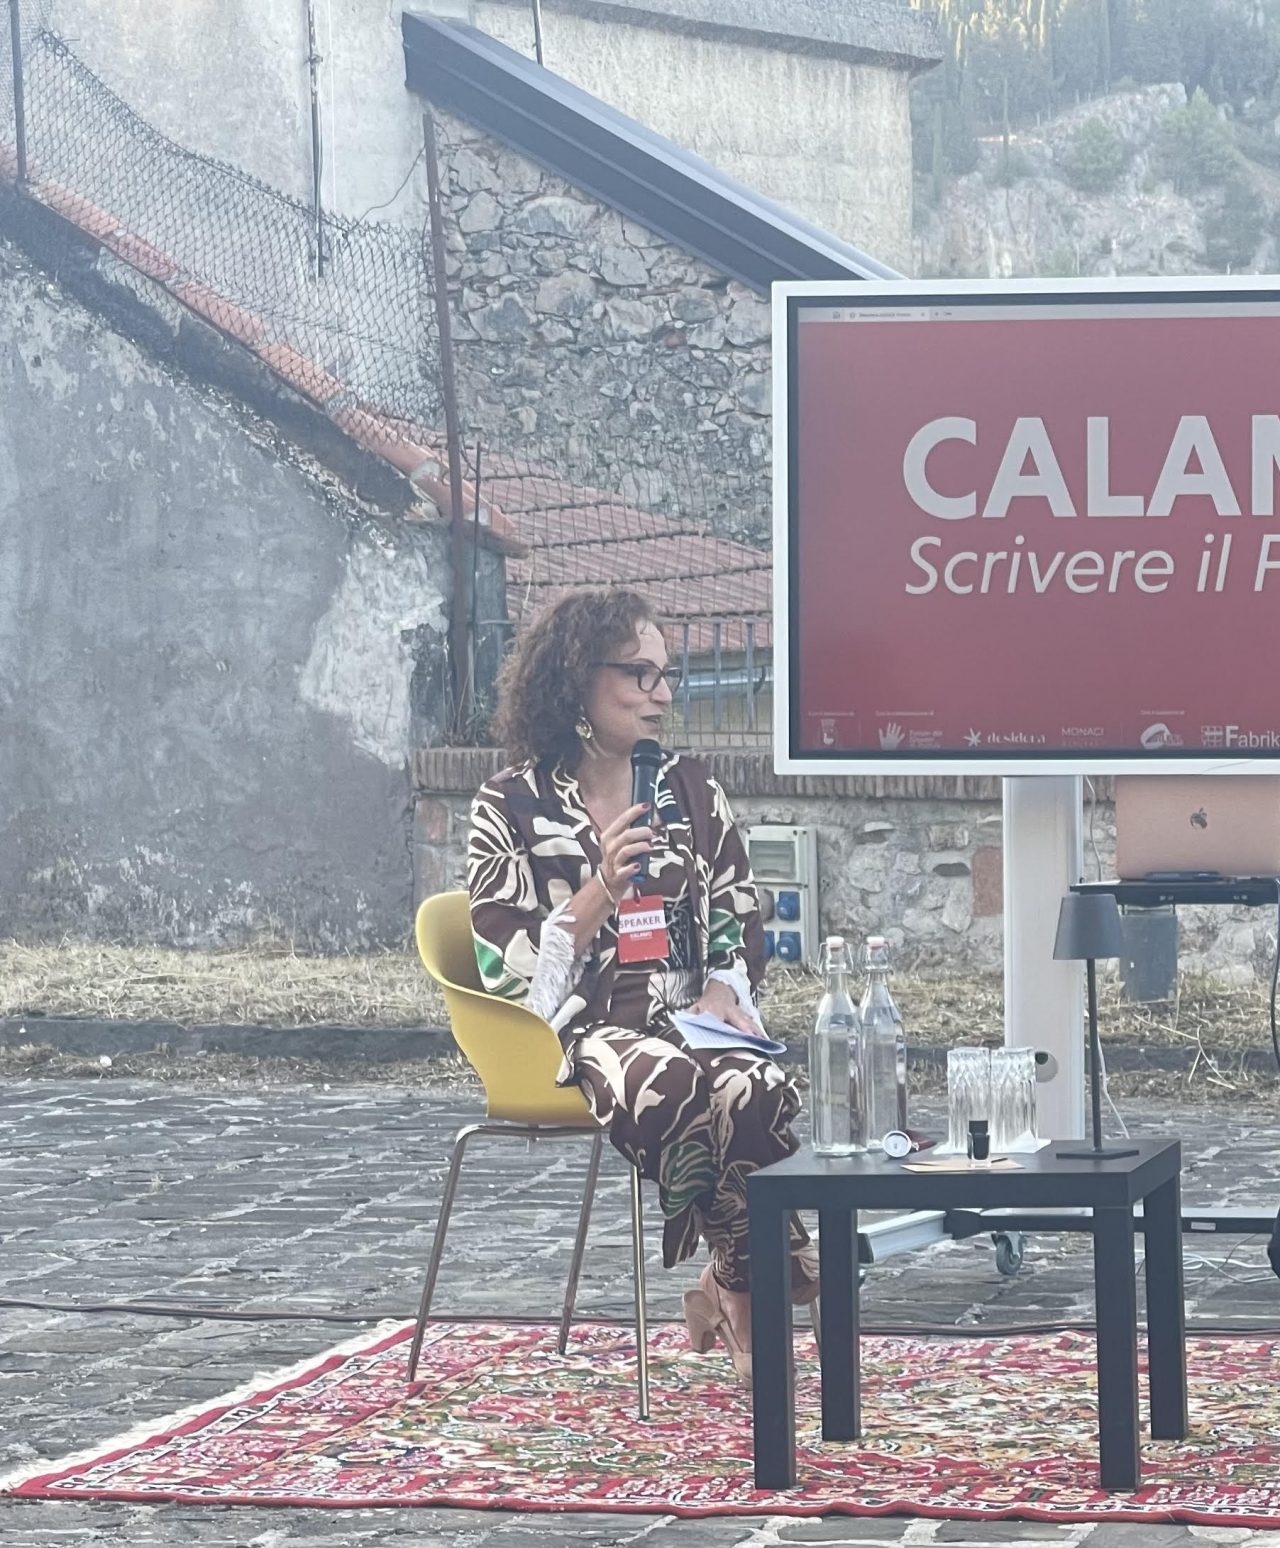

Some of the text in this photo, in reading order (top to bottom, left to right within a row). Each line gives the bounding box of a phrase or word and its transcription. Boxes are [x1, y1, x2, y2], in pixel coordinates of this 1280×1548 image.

[905, 534, 1175, 595] Scrivere
[1196, 533, 1233, 593] il
[1061, 727, 1104, 737] MONACI
[618, 915, 661, 929] SPEAKER
